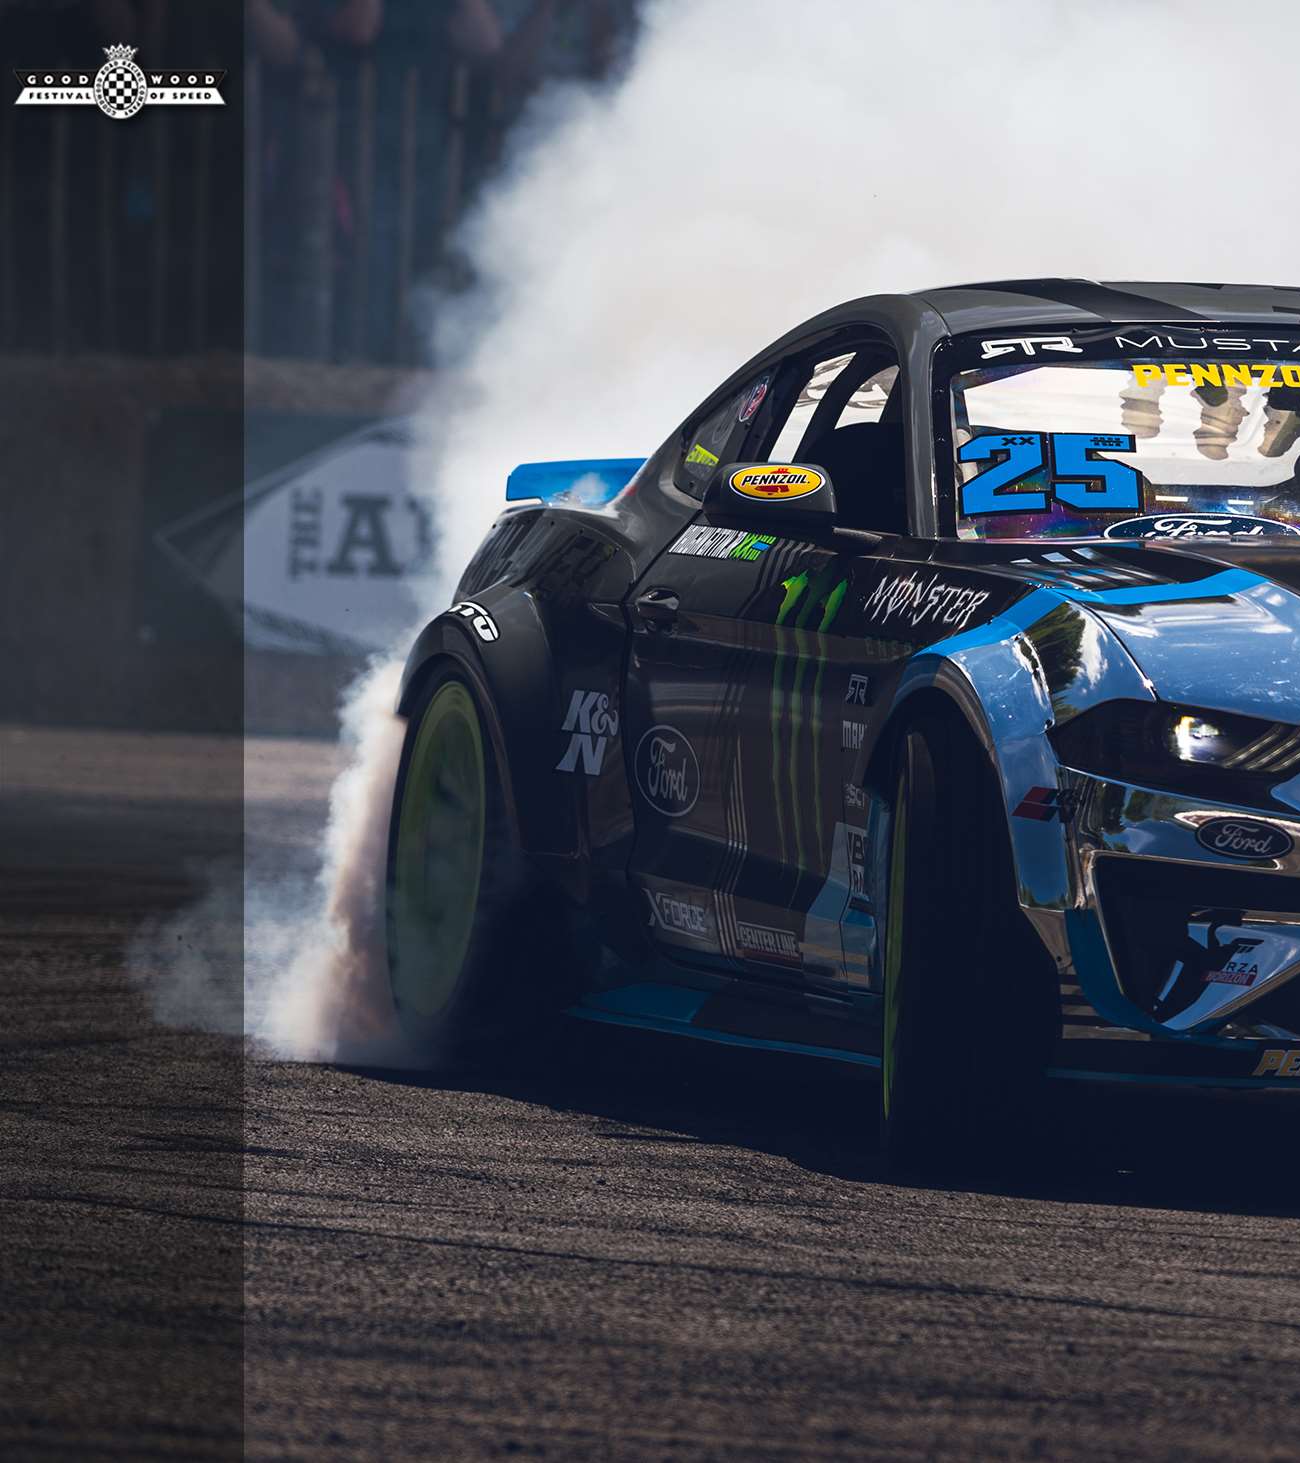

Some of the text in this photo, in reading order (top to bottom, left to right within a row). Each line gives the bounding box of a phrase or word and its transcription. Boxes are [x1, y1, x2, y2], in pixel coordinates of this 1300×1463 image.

[957, 433, 1144, 515] 25
[648, 736, 688, 802] Ford
[1214, 823, 1273, 854] Ford
